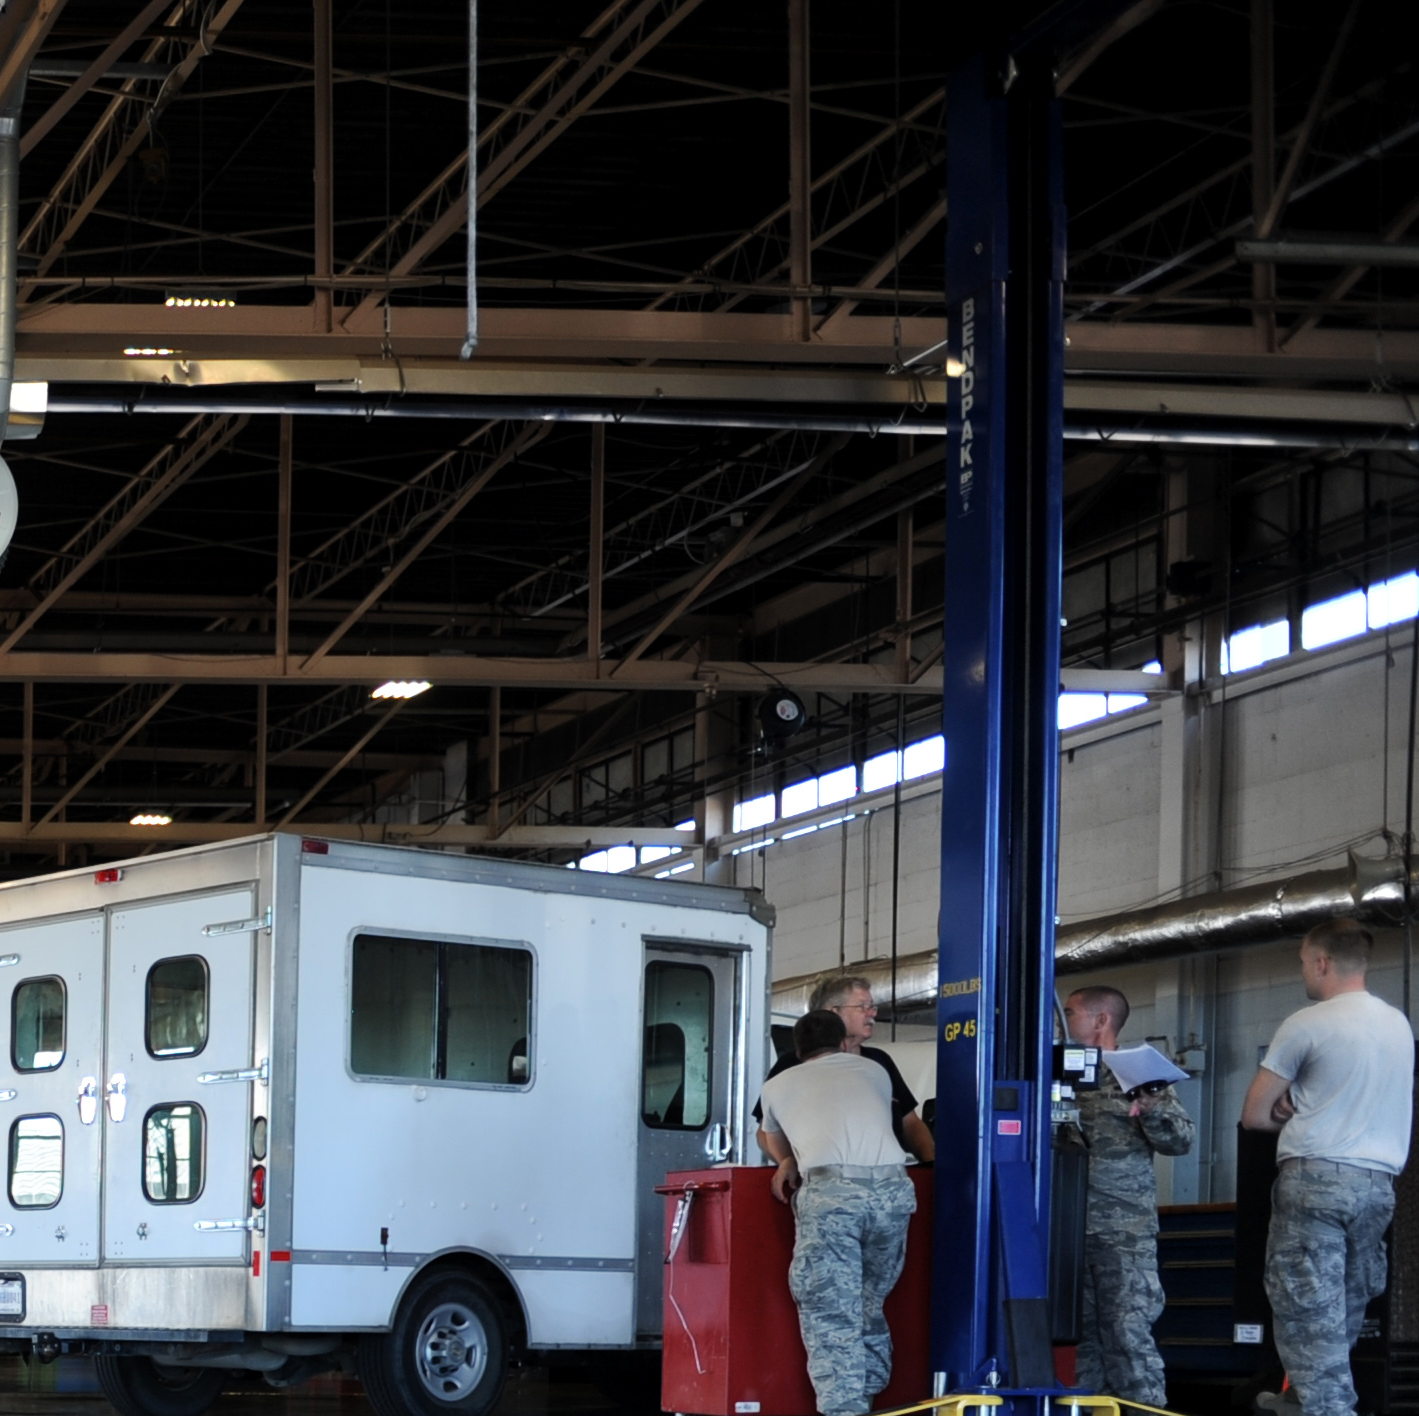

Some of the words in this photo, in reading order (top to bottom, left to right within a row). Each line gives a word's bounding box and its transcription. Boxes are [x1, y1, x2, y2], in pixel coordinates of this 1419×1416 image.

[959, 297, 976, 470] BENDPAK
[944, 1021, 962, 1043] GP
[962, 1018, 976, 1038] 45
